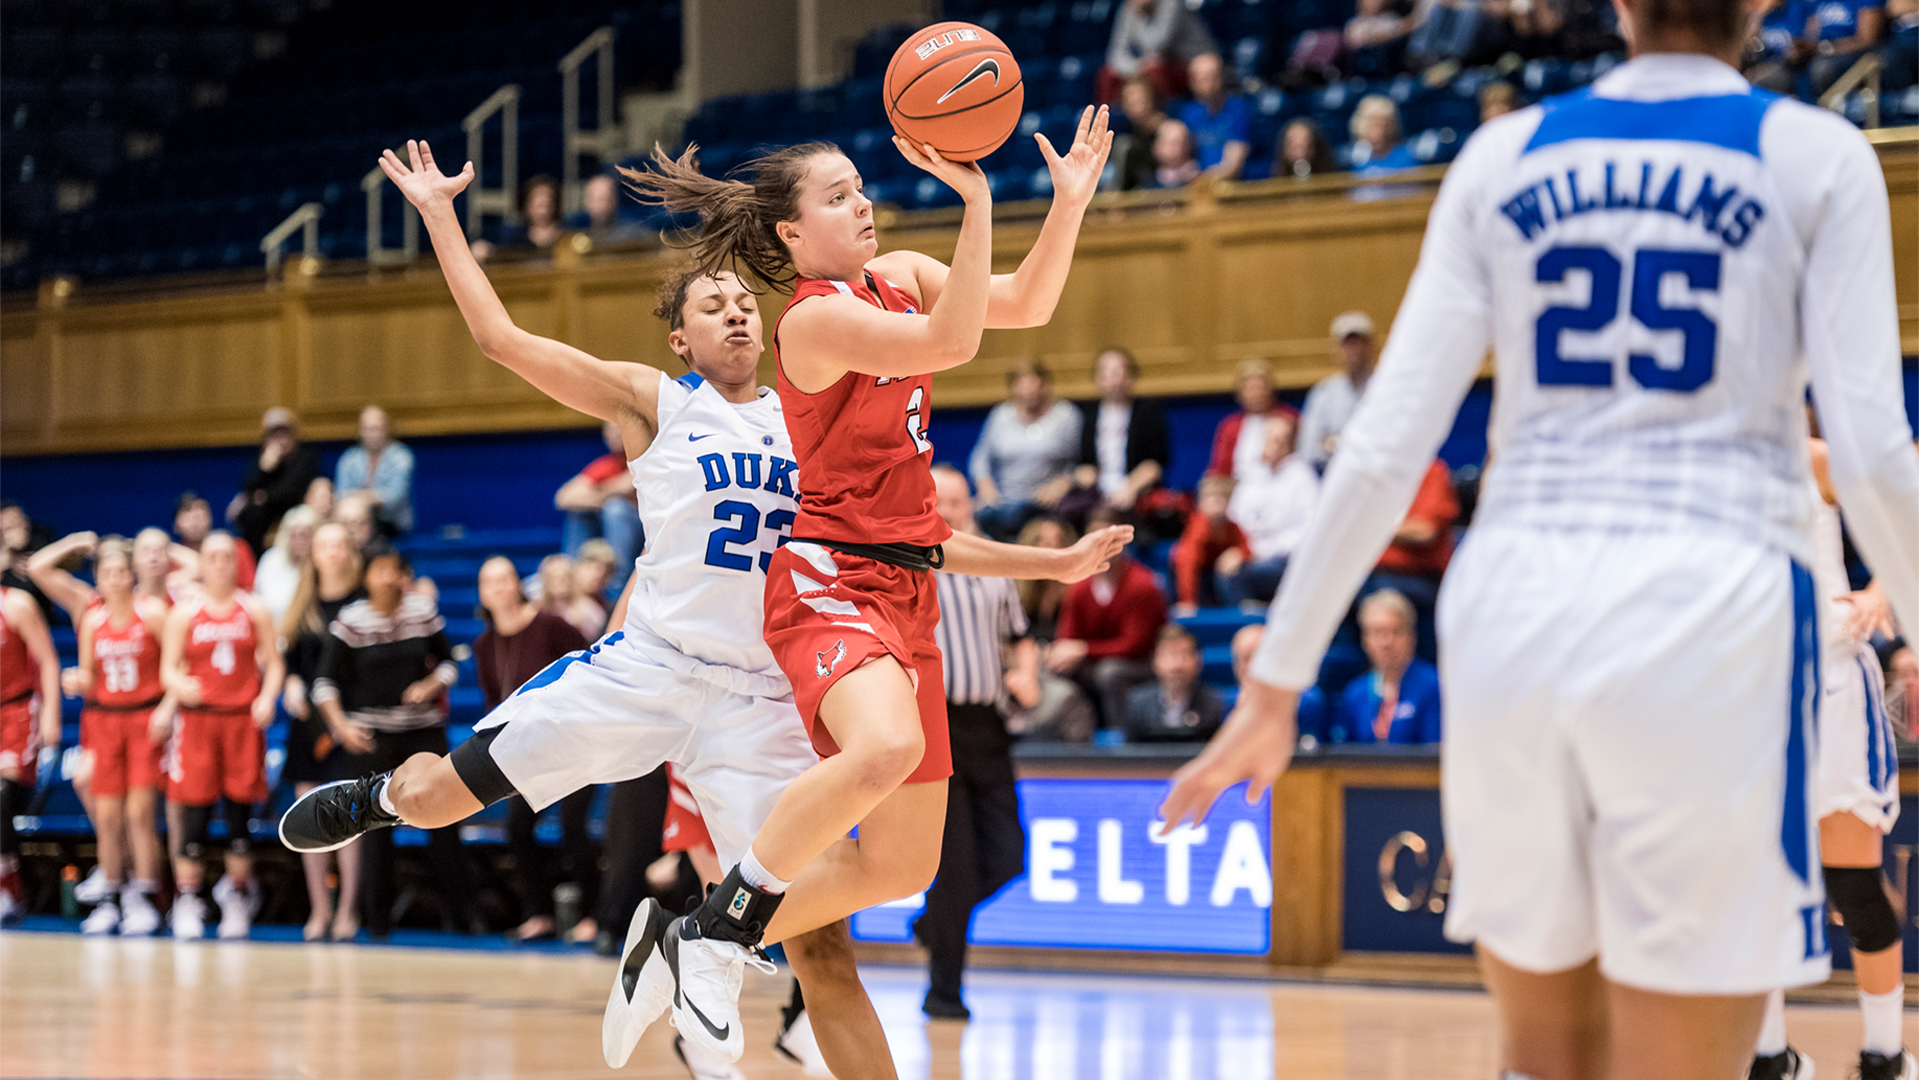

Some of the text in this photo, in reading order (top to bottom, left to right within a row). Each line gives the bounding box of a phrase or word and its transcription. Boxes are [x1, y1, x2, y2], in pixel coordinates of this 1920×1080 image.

[915, 28, 981, 60] ELITE
[1499, 161, 1764, 248] WILLIAMS
[1536, 247, 1721, 392] 25
[697, 452, 802, 500] DUK
[1030, 818, 1272, 907] ELTA
